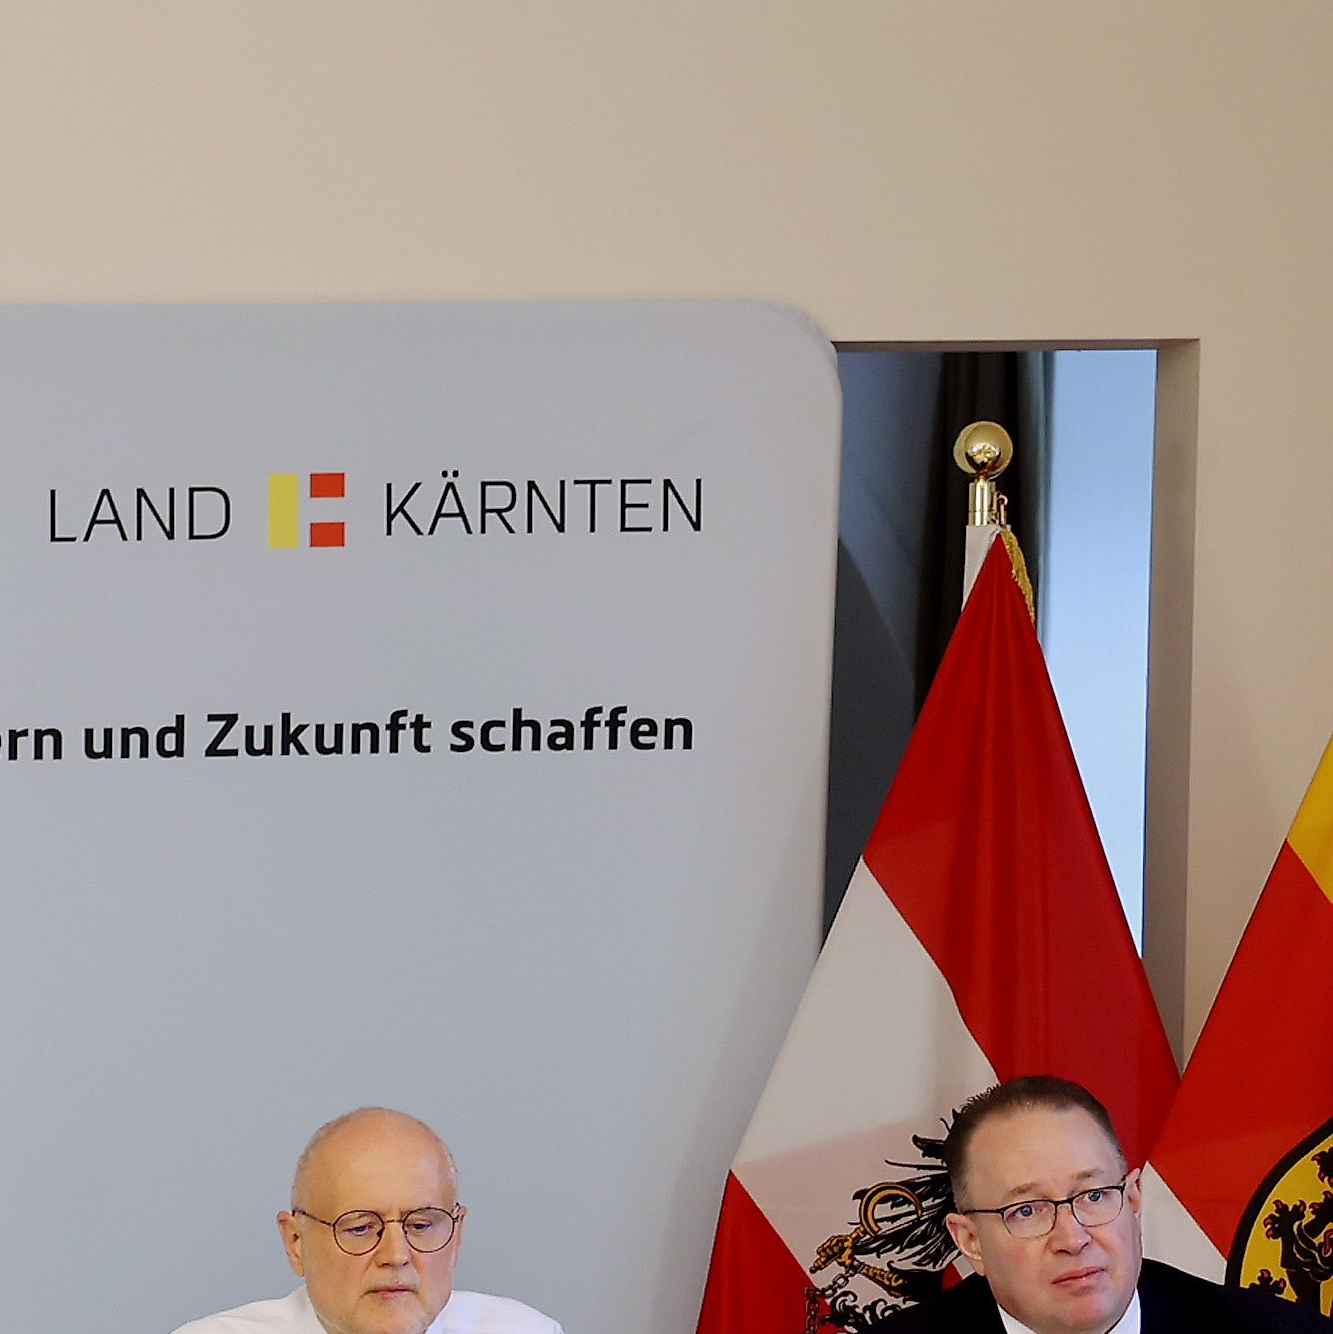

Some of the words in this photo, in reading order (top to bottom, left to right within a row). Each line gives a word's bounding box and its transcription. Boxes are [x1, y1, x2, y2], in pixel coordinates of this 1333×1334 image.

[49, 486, 231, 543] LAND
[385, 469, 703, 537] KÄRNTEN
[83, 713, 186, 759] und
[204, 708, 432, 758] Zukunft
[449, 704, 693, 753] schaffen
